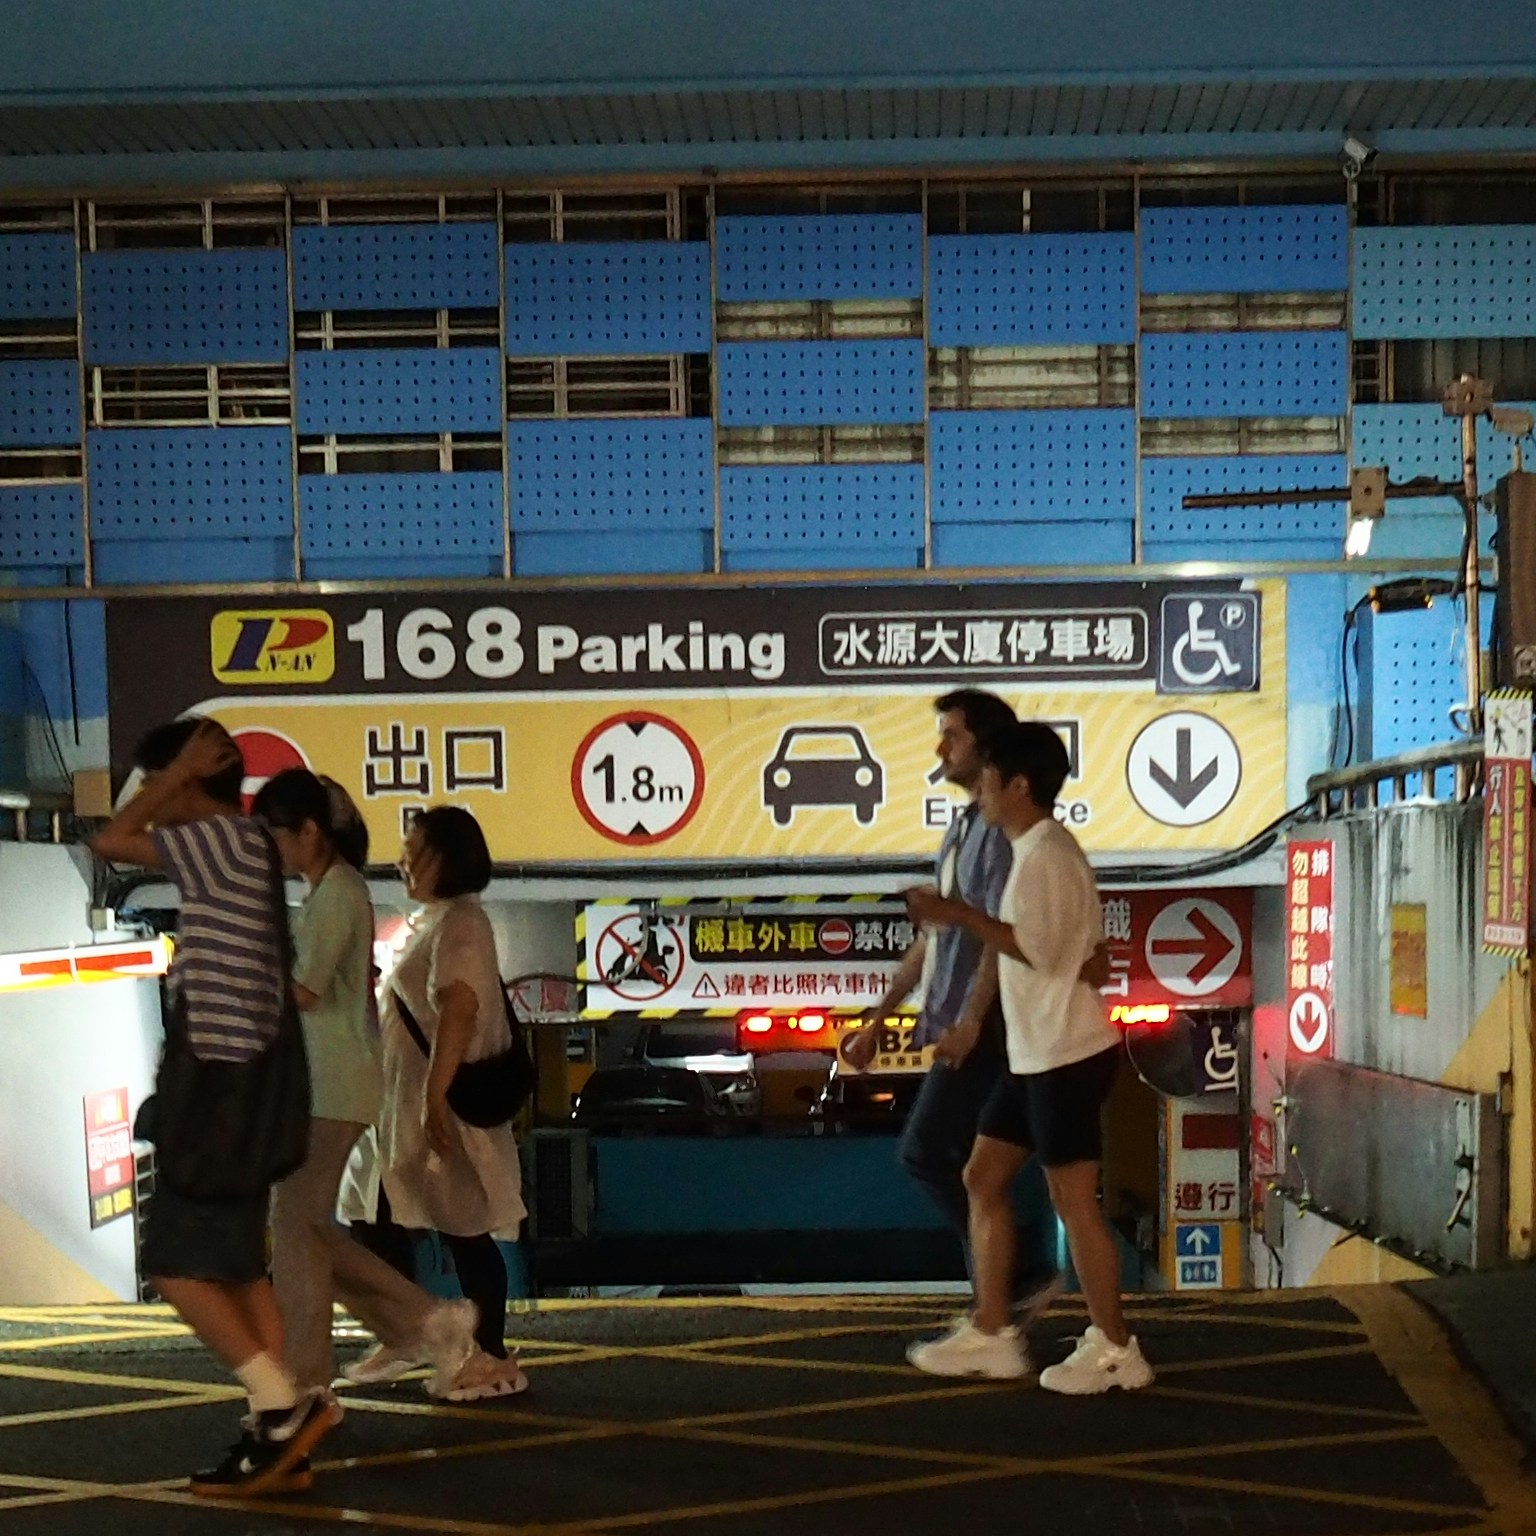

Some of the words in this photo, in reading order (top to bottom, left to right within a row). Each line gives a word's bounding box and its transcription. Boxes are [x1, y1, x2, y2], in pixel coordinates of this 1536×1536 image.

[347, 607, 524, 680] 168
[537, 621, 785, 680] Parking
[833, 618, 1134, 666] 水源大廈停車場
[364, 724, 506, 796] 出口
[592, 754, 684, 804] 1.8m
[695, 918, 818, 953] 機車外車
